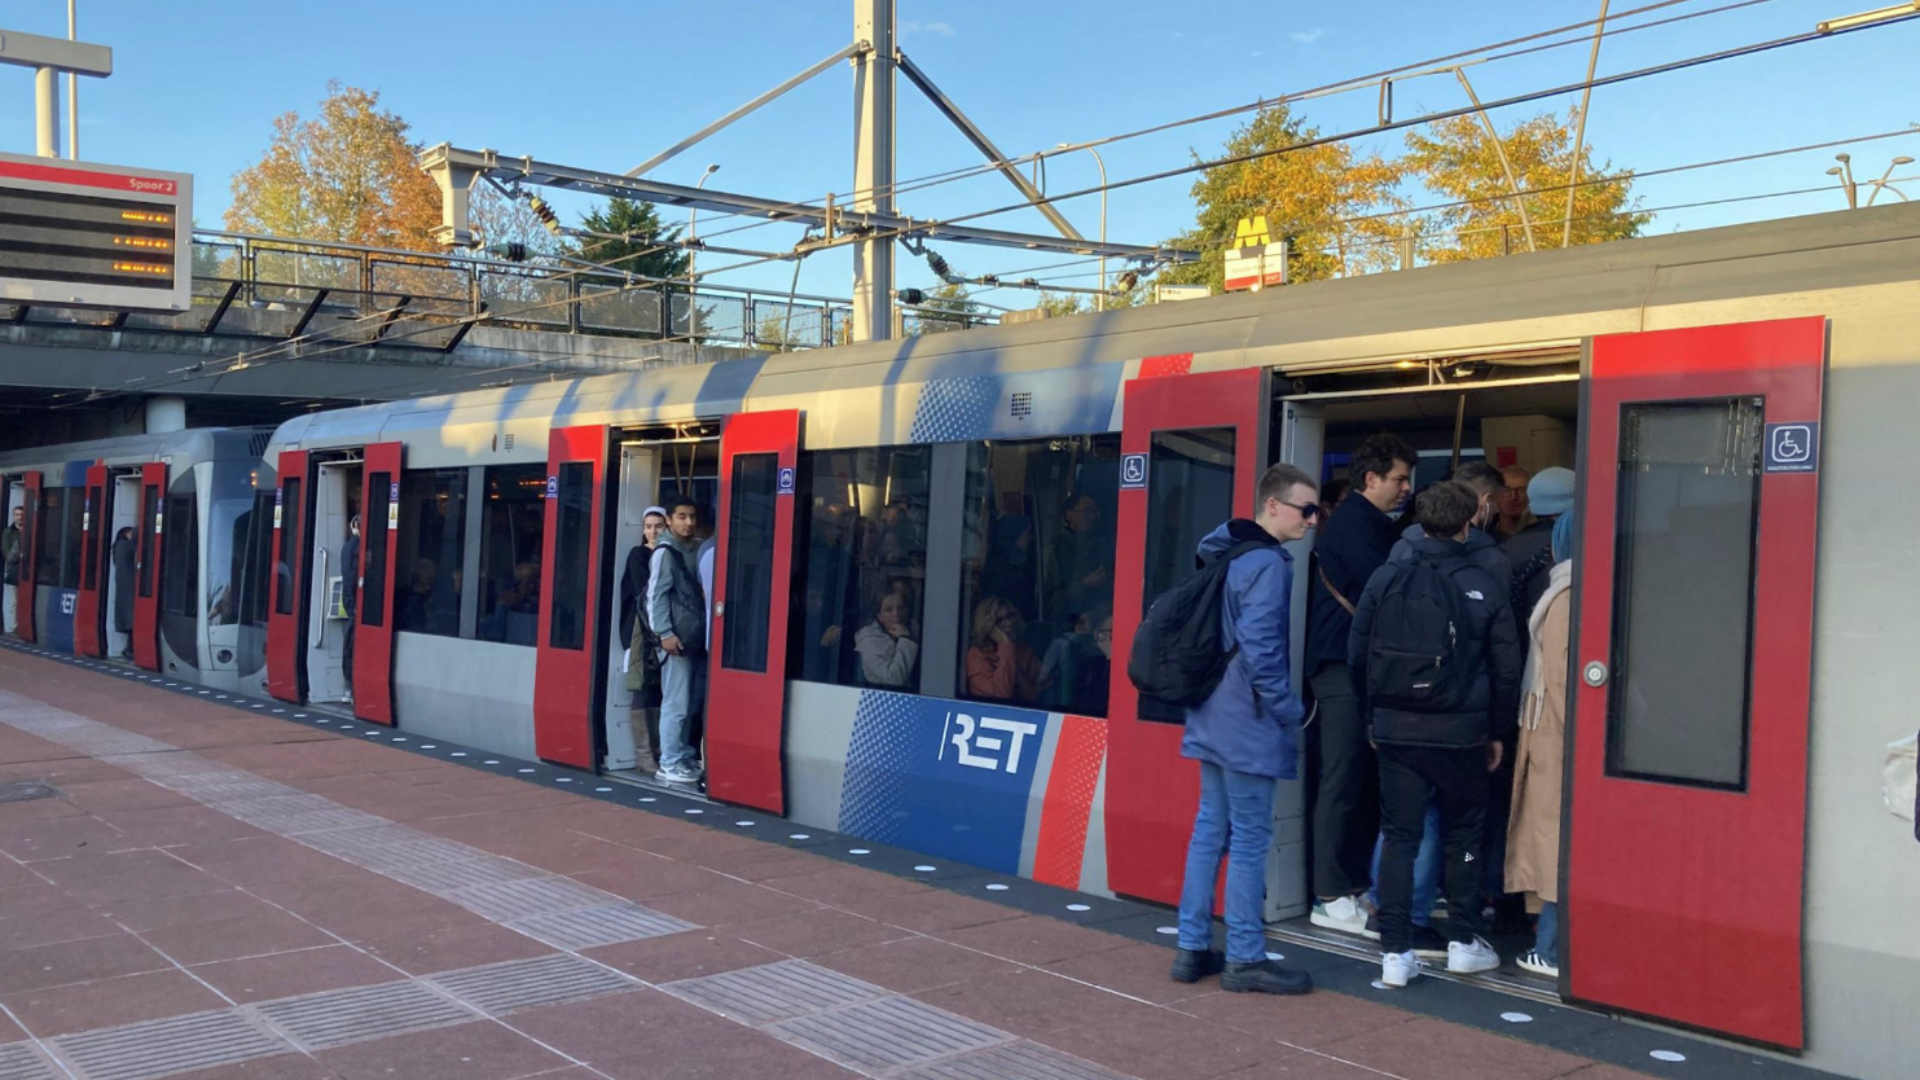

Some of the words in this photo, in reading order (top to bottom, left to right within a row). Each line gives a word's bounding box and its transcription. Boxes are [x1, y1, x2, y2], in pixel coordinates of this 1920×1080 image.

[129, 178, 163, 191] Spoor
[166, 182, 173, 192] 2
[60, 592, 76, 615] RET
[938, 711, 1037, 774] RET
